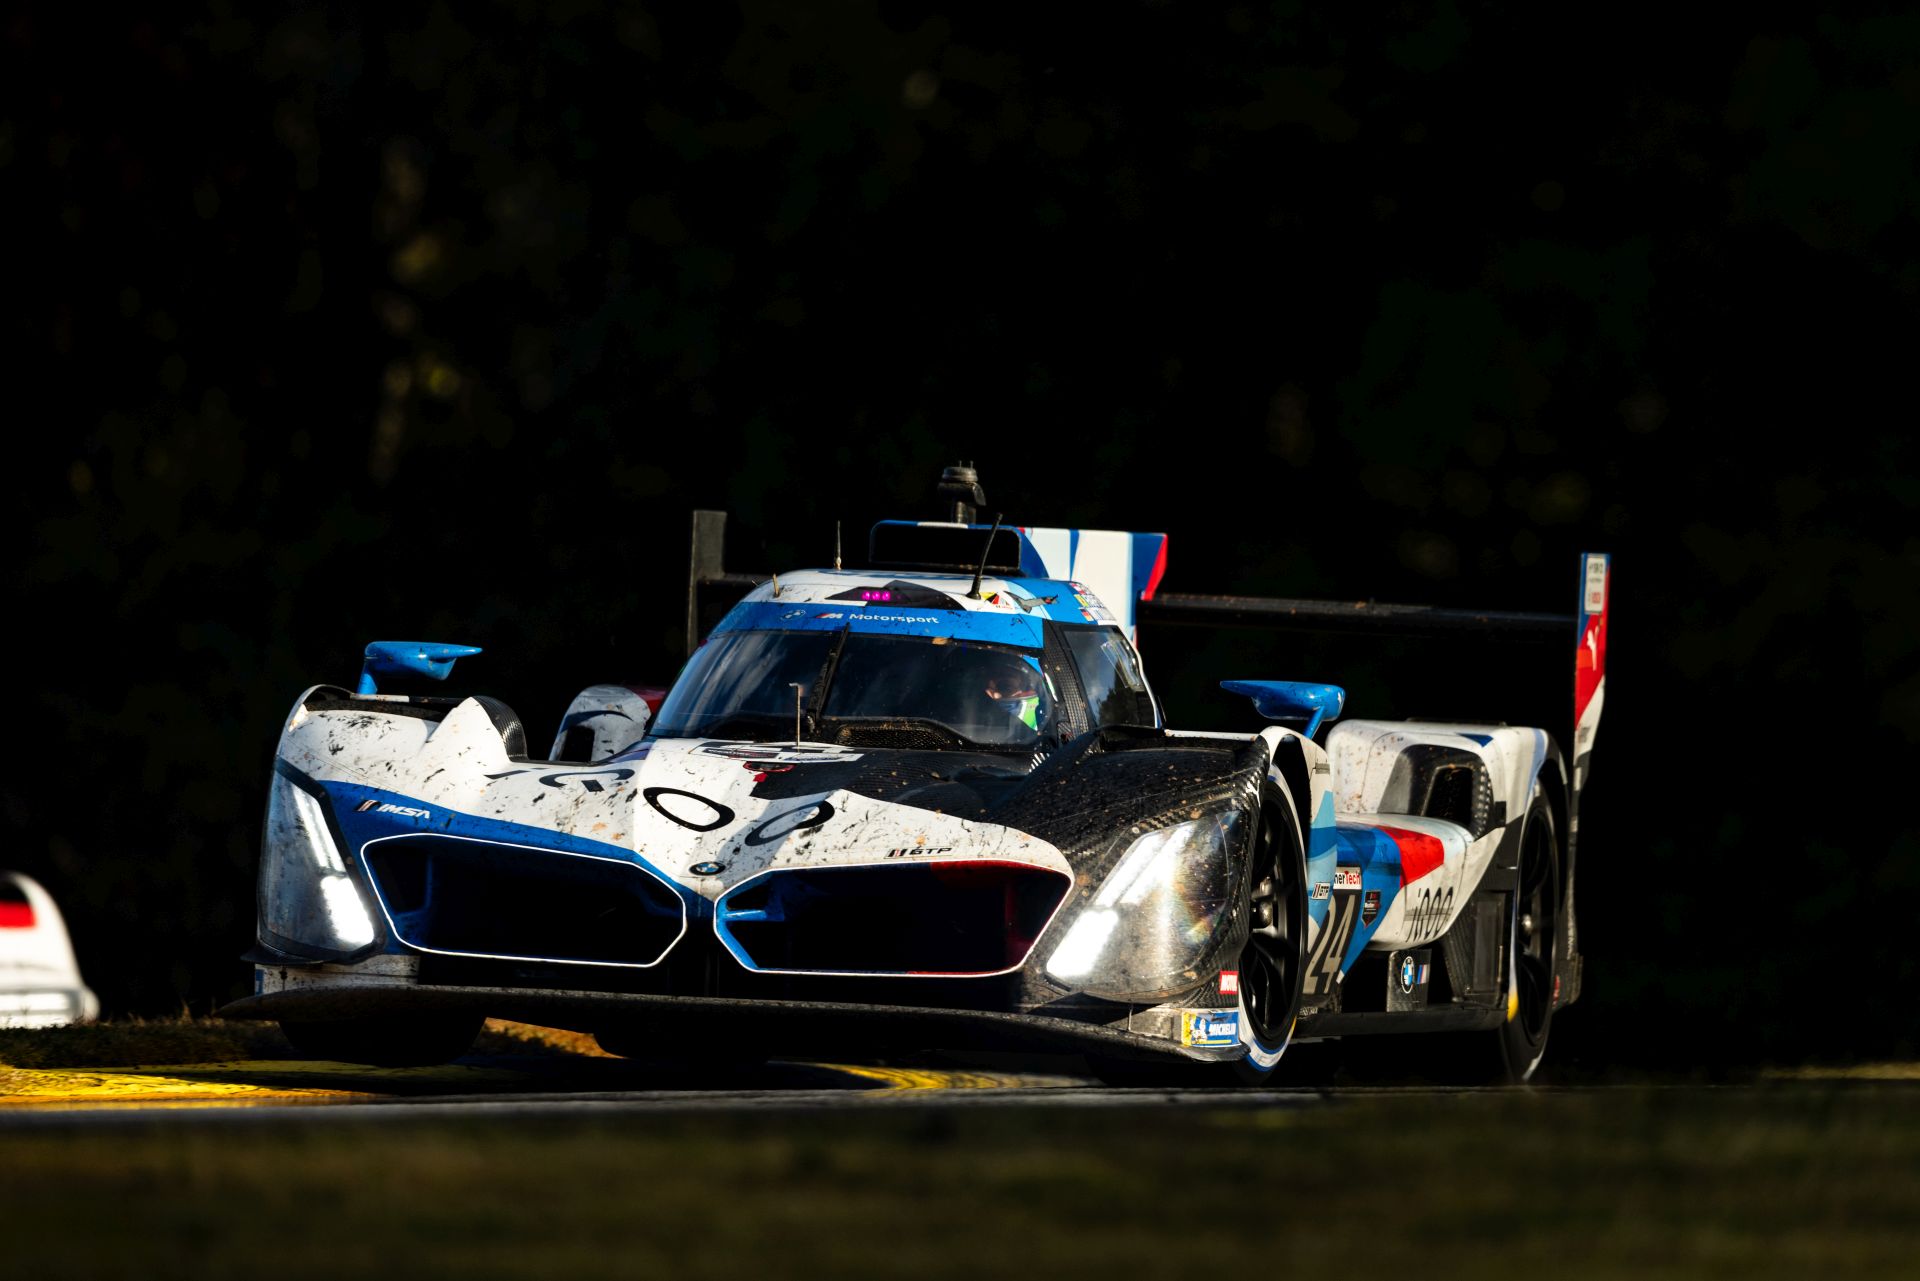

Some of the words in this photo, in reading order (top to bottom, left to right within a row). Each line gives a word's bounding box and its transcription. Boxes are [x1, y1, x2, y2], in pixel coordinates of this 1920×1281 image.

[849, 613, 939, 624] Motorsport
[376, 803, 431, 819] IMSA
[909, 847, 952, 855] GTP
[1302, 894, 1357, 994] 24
